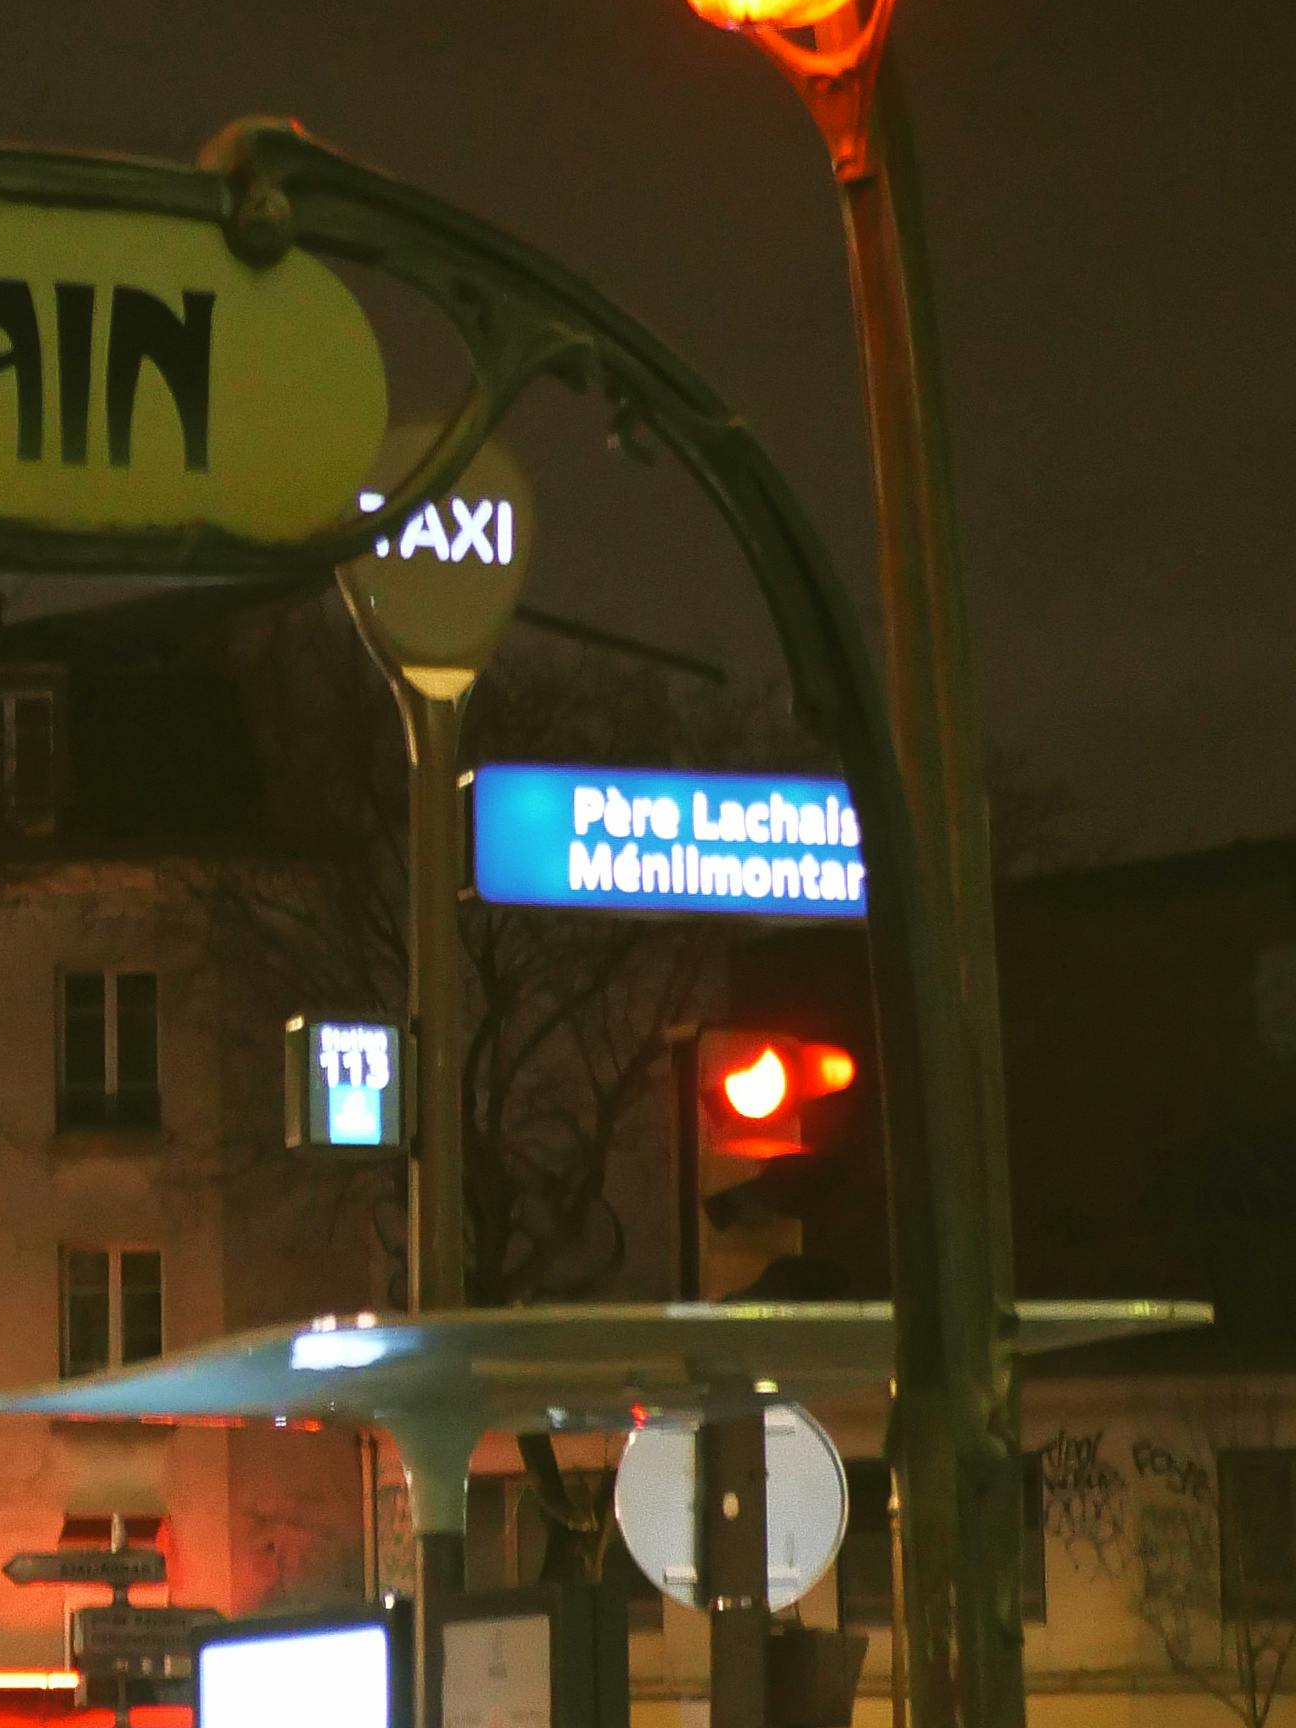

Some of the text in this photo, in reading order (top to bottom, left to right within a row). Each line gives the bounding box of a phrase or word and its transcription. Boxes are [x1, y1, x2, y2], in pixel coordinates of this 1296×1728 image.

[574, 785, 860, 847] Père Lachais
[319, 1050, 389, 1089] 113
